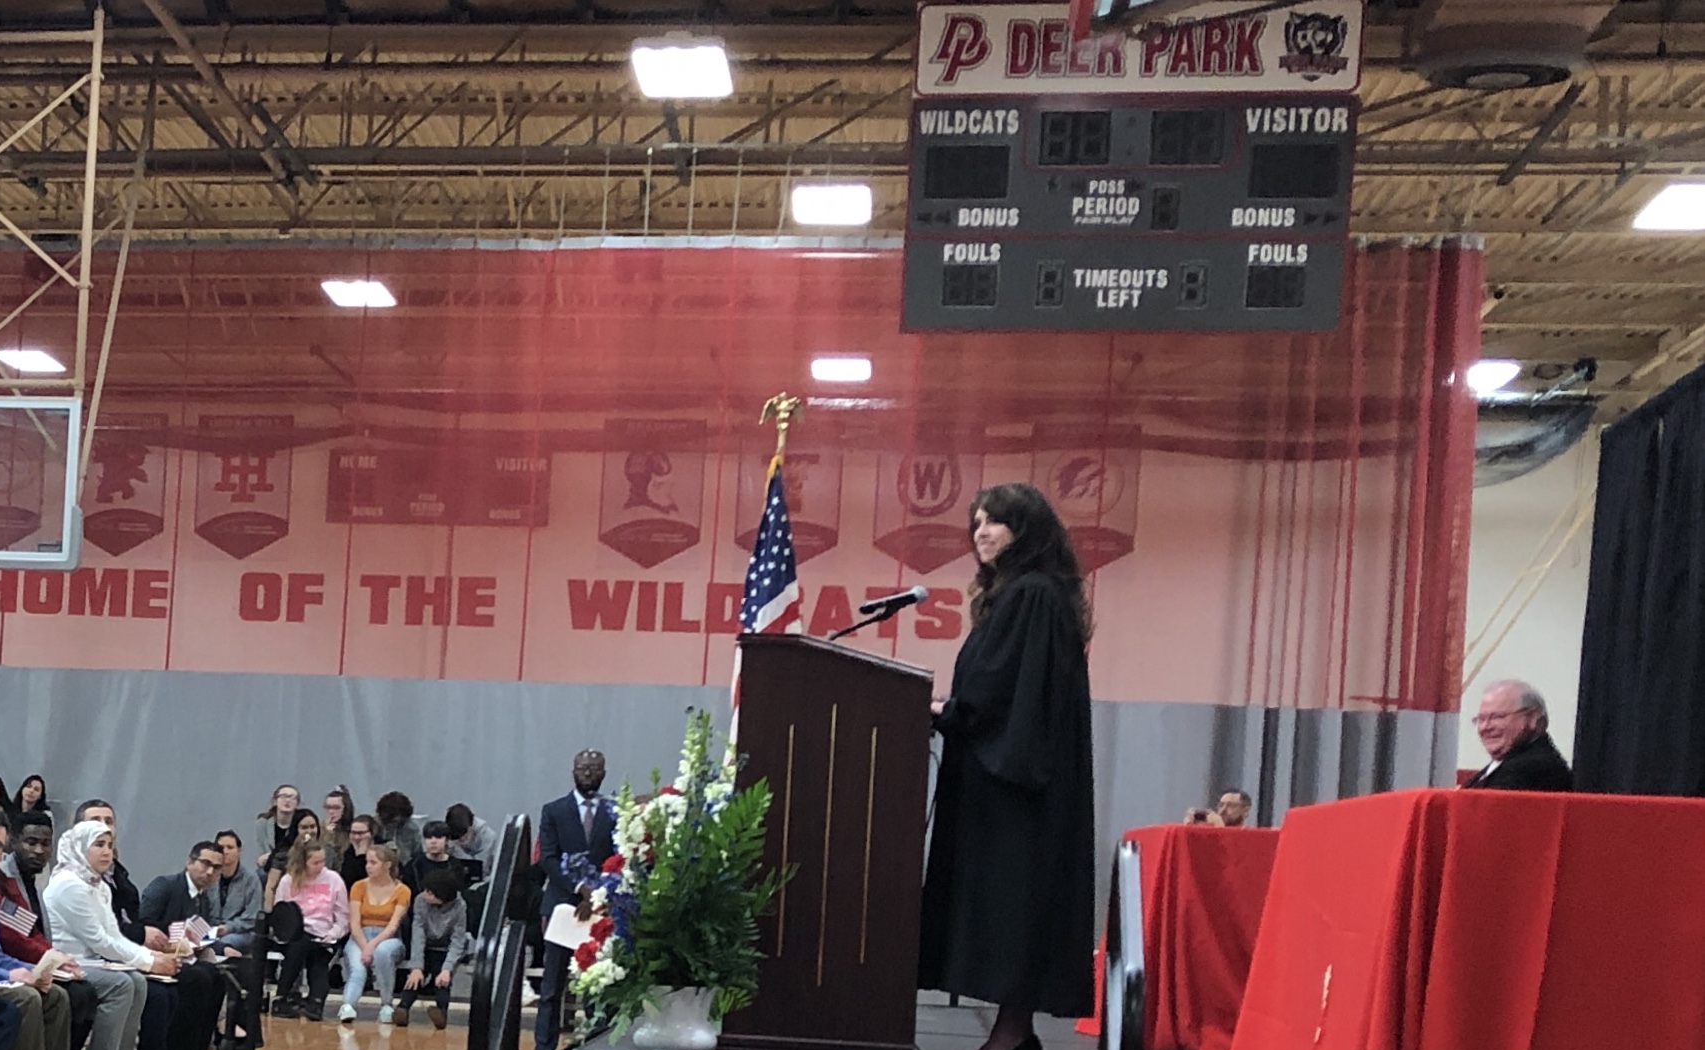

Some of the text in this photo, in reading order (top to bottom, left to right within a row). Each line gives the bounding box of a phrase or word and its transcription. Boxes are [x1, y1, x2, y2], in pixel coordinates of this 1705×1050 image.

[1140, 15, 1268, 78] PARK
[919, 109, 1019, 136] WILDCATS
[1246, 107, 1349, 135] VISITOR
[1089, 179, 1125, 194] POSS
[1072, 197, 1140, 216] PERIOD
[957, 208, 1020, 229] BONUS
[1231, 208, 1295, 228] BONUS
[943, 243, 1001, 262] FOULS
[1247, 243, 1308, 263] FOULS
[1073, 269, 1168, 288] TIMEOUTS
[1097, 289, 1142, 309] LEFT
[238, 572, 324, 623] OF
[360, 574, 496, 627] THE
[567, 579, 963, 641] WILDATS
